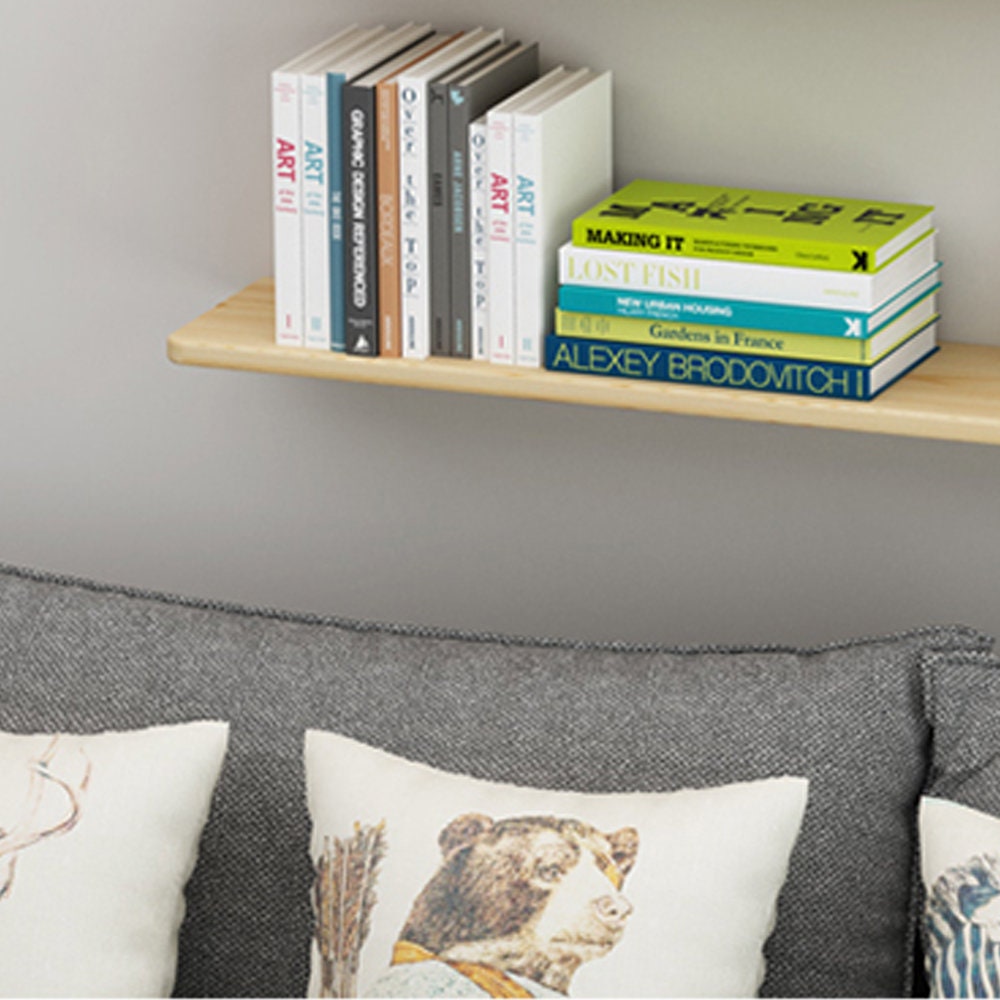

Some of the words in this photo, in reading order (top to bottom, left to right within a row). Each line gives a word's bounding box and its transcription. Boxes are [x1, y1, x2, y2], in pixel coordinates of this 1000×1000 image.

[276, 137, 296, 182] ART
[350, 108, 366, 168] GRAPHIC
[303, 140, 324, 185] ART
[352, 170, 366, 219] DESIGN
[489, 172, 510, 214] ART
[516, 174, 535, 217] ART
[586, 228, 660, 251] MAKING
[665, 236, 685, 252] IT
[352, 221, 367, 308] REFERENCED
[567, 256, 638, 286] LOST
[642, 262, 701, 291] FISH
[616, 296, 641, 308] NEW
[644, 298, 681, 311] URBAN
[683, 303, 733, 318] HOUSING
[649, 323, 711, 343] Gardens
[714, 330, 730, 344] in
[733, 329, 784, 351] France
[553, 343, 660, 376] ALEXEY
[668, 352, 848, 394] BRODOVITCH
